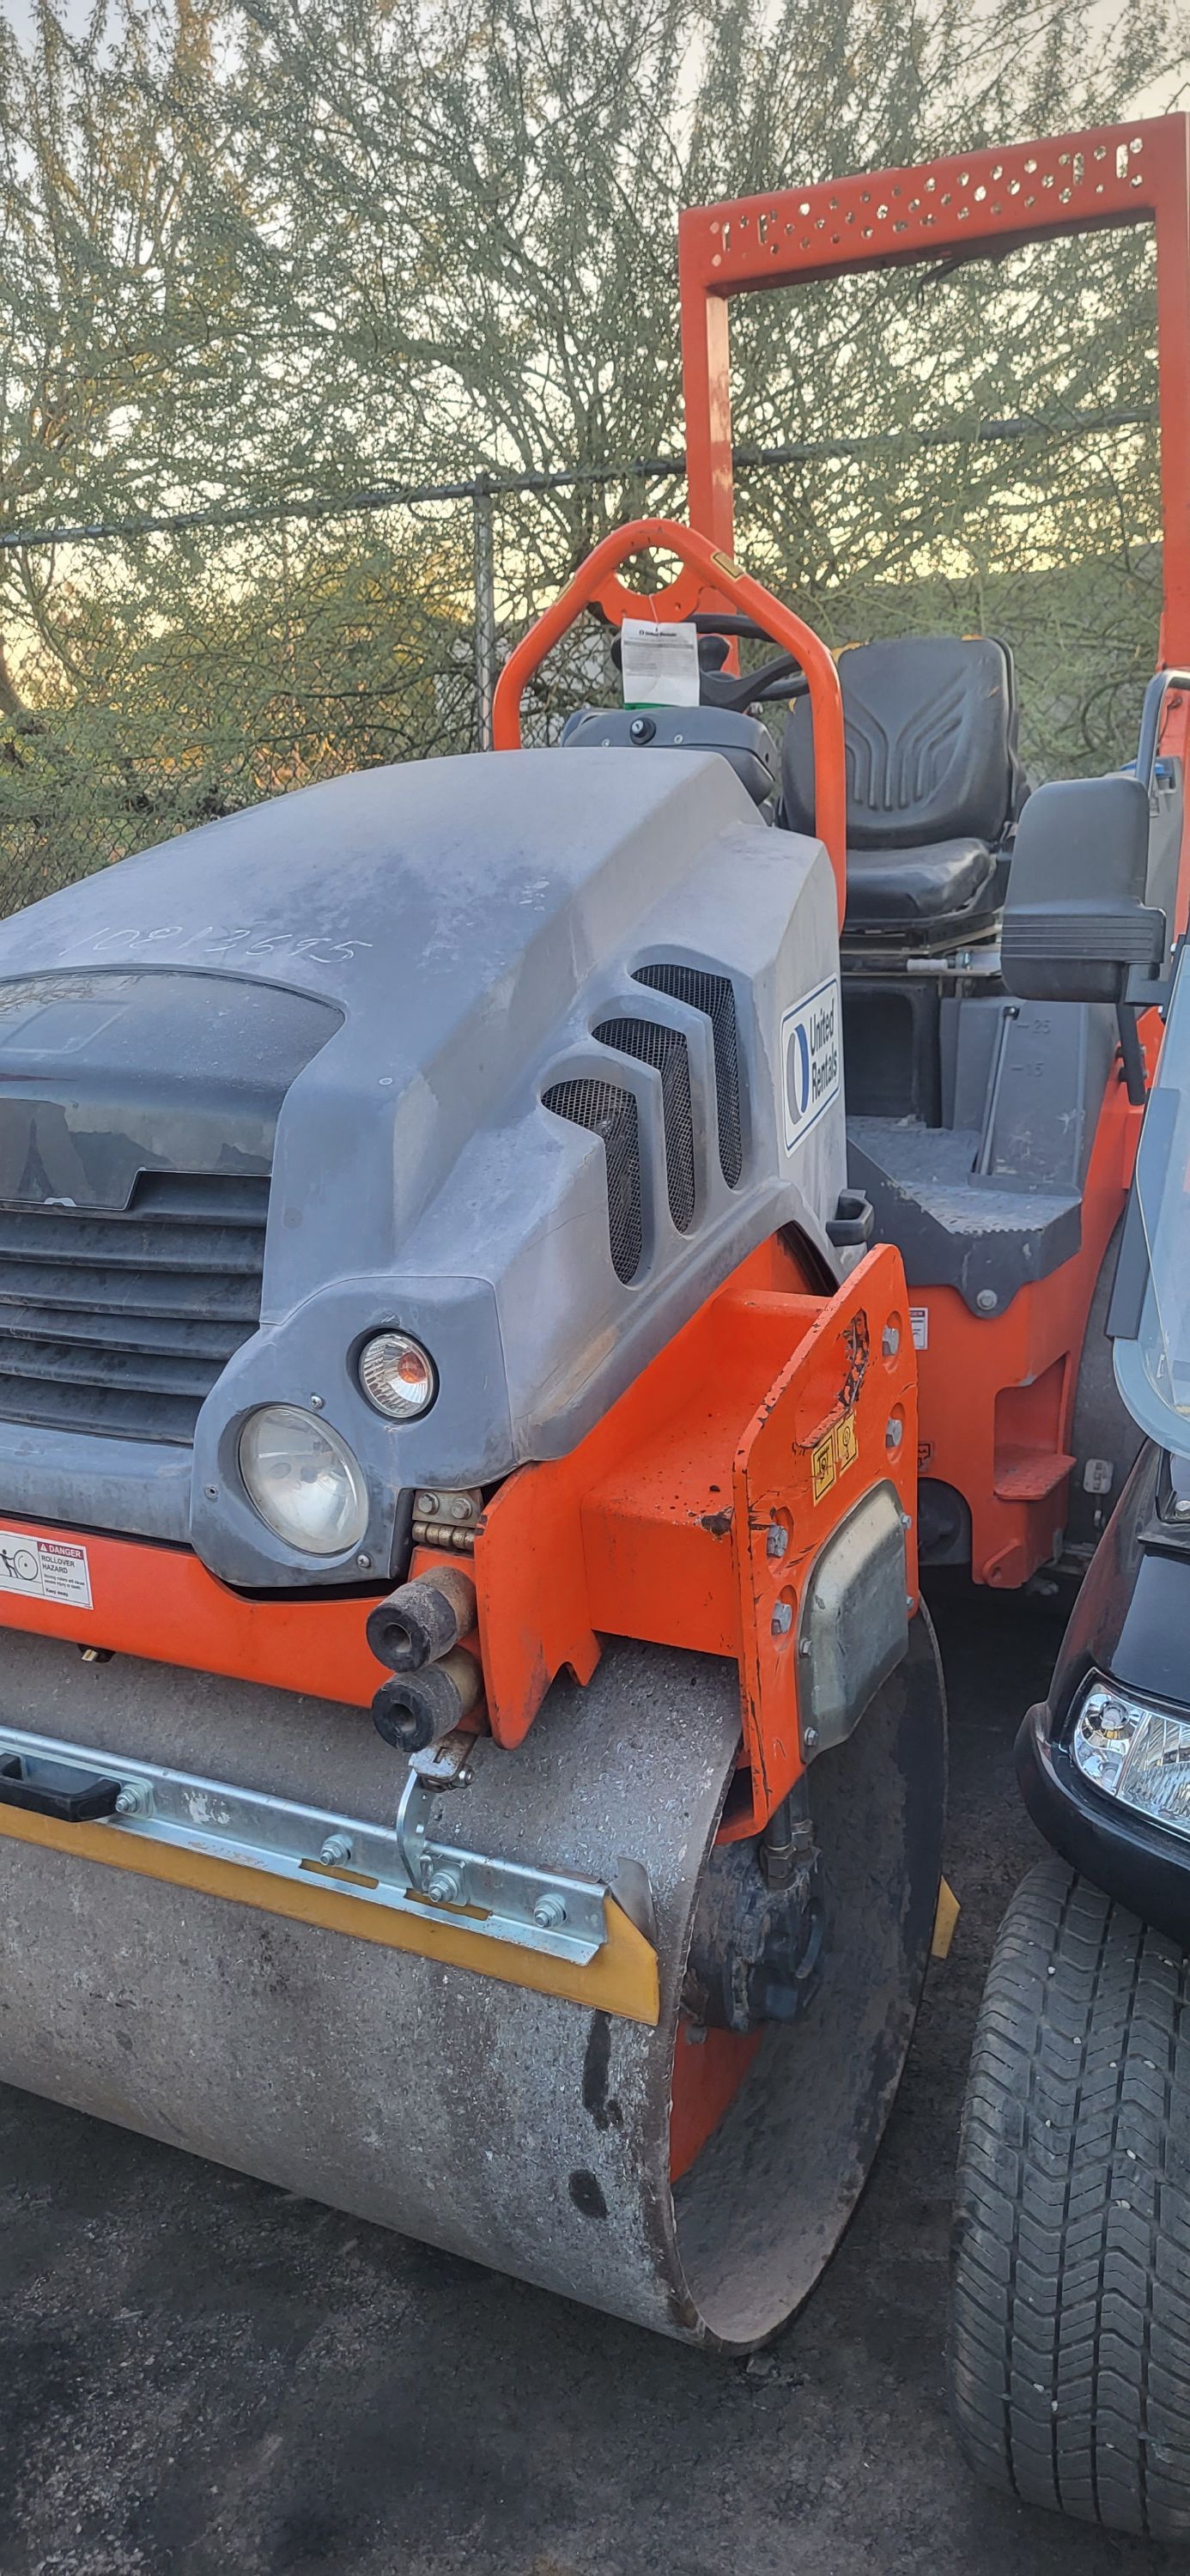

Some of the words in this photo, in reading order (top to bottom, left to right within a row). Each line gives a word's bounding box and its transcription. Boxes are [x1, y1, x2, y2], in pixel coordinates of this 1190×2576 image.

[810, 998, 835, 1056] United
[811, 1042, 838, 1103] Rentals
[49, 1546, 82, 1558] DANGER
[41, 1555, 76, 1567] ROLLOVER
[42, 1563, 68, 1574] HAZARD
